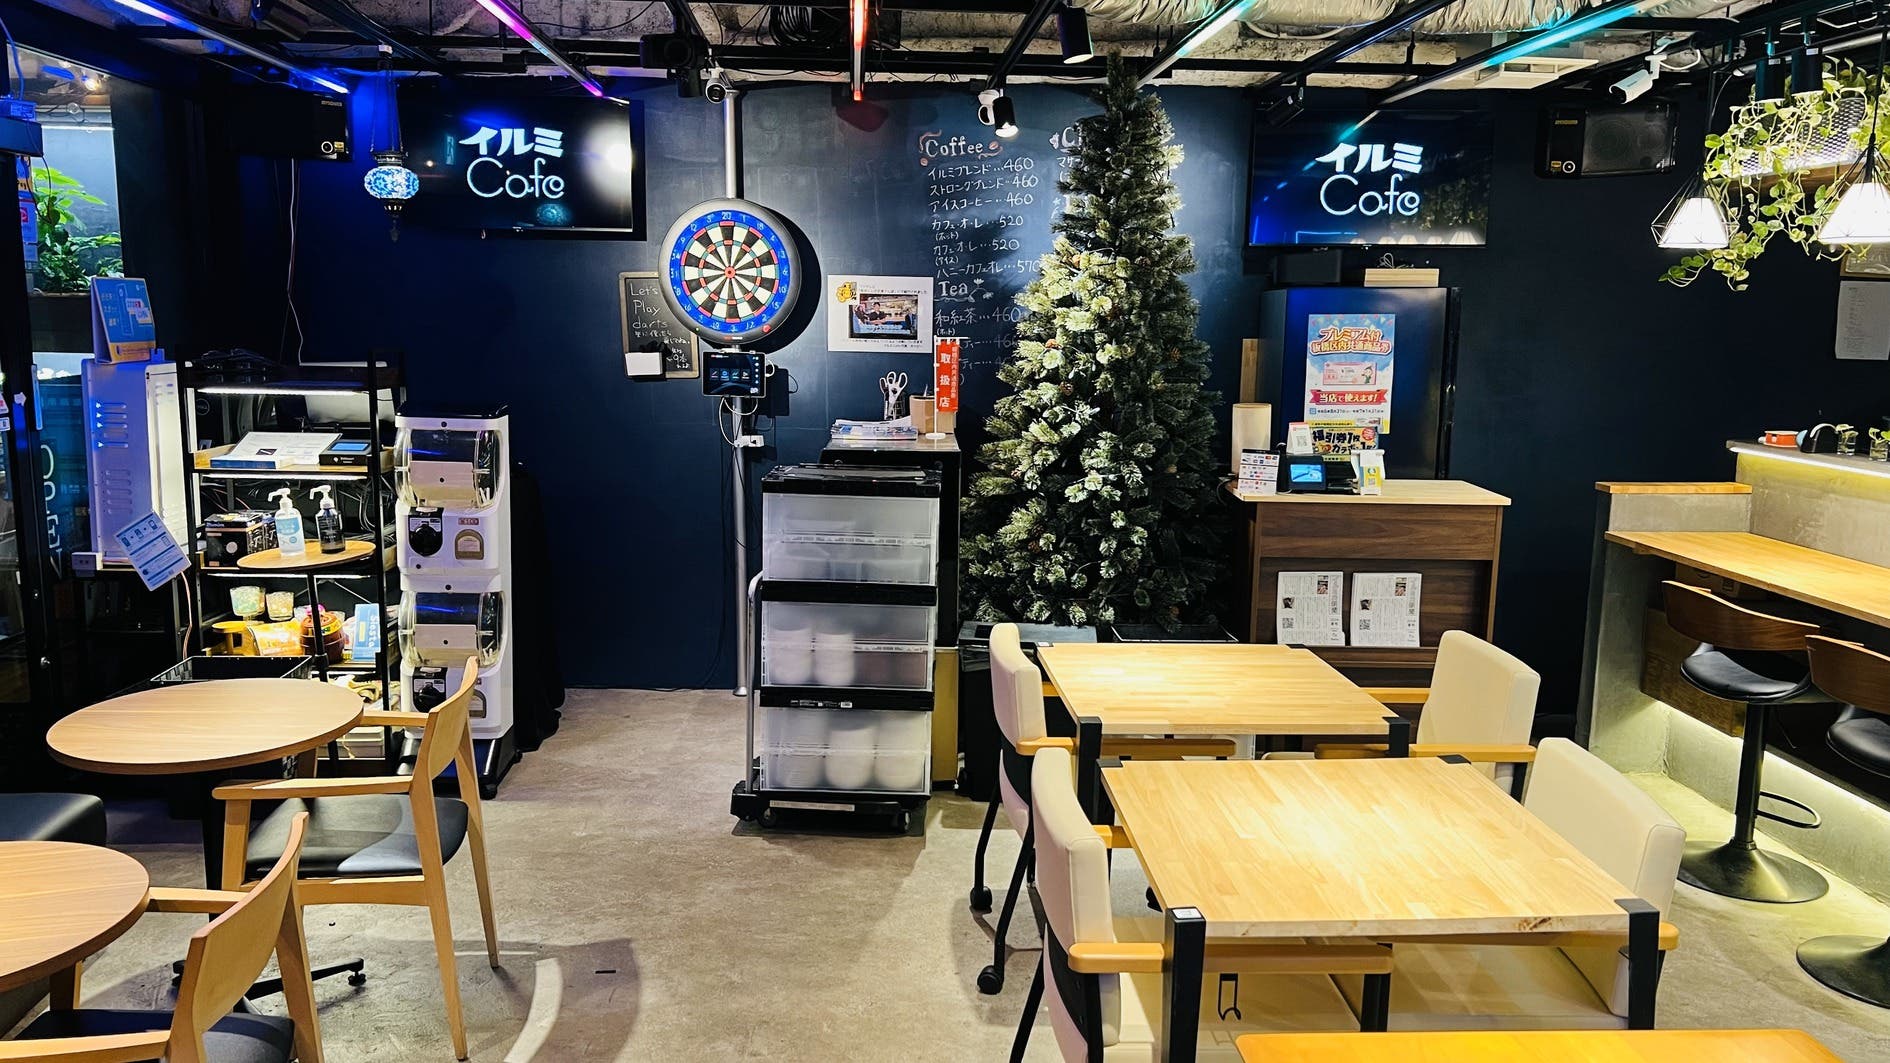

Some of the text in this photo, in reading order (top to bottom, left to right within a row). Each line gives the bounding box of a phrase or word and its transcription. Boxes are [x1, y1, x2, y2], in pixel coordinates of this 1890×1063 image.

[459, 126, 564, 158] イルミ
[925, 136, 984, 158] Coffee
[1315, 143, 1424, 174] イルミ
[467, 157, 565, 199] Cafe
[1320, 174, 1421, 216] Cafe
[721, 211, 732, 220] 20
[630, 281, 659, 297] Let's
[938, 280, 969, 297] Tea
[633, 299, 660, 316] Play
[632, 316, 669, 329] darts
